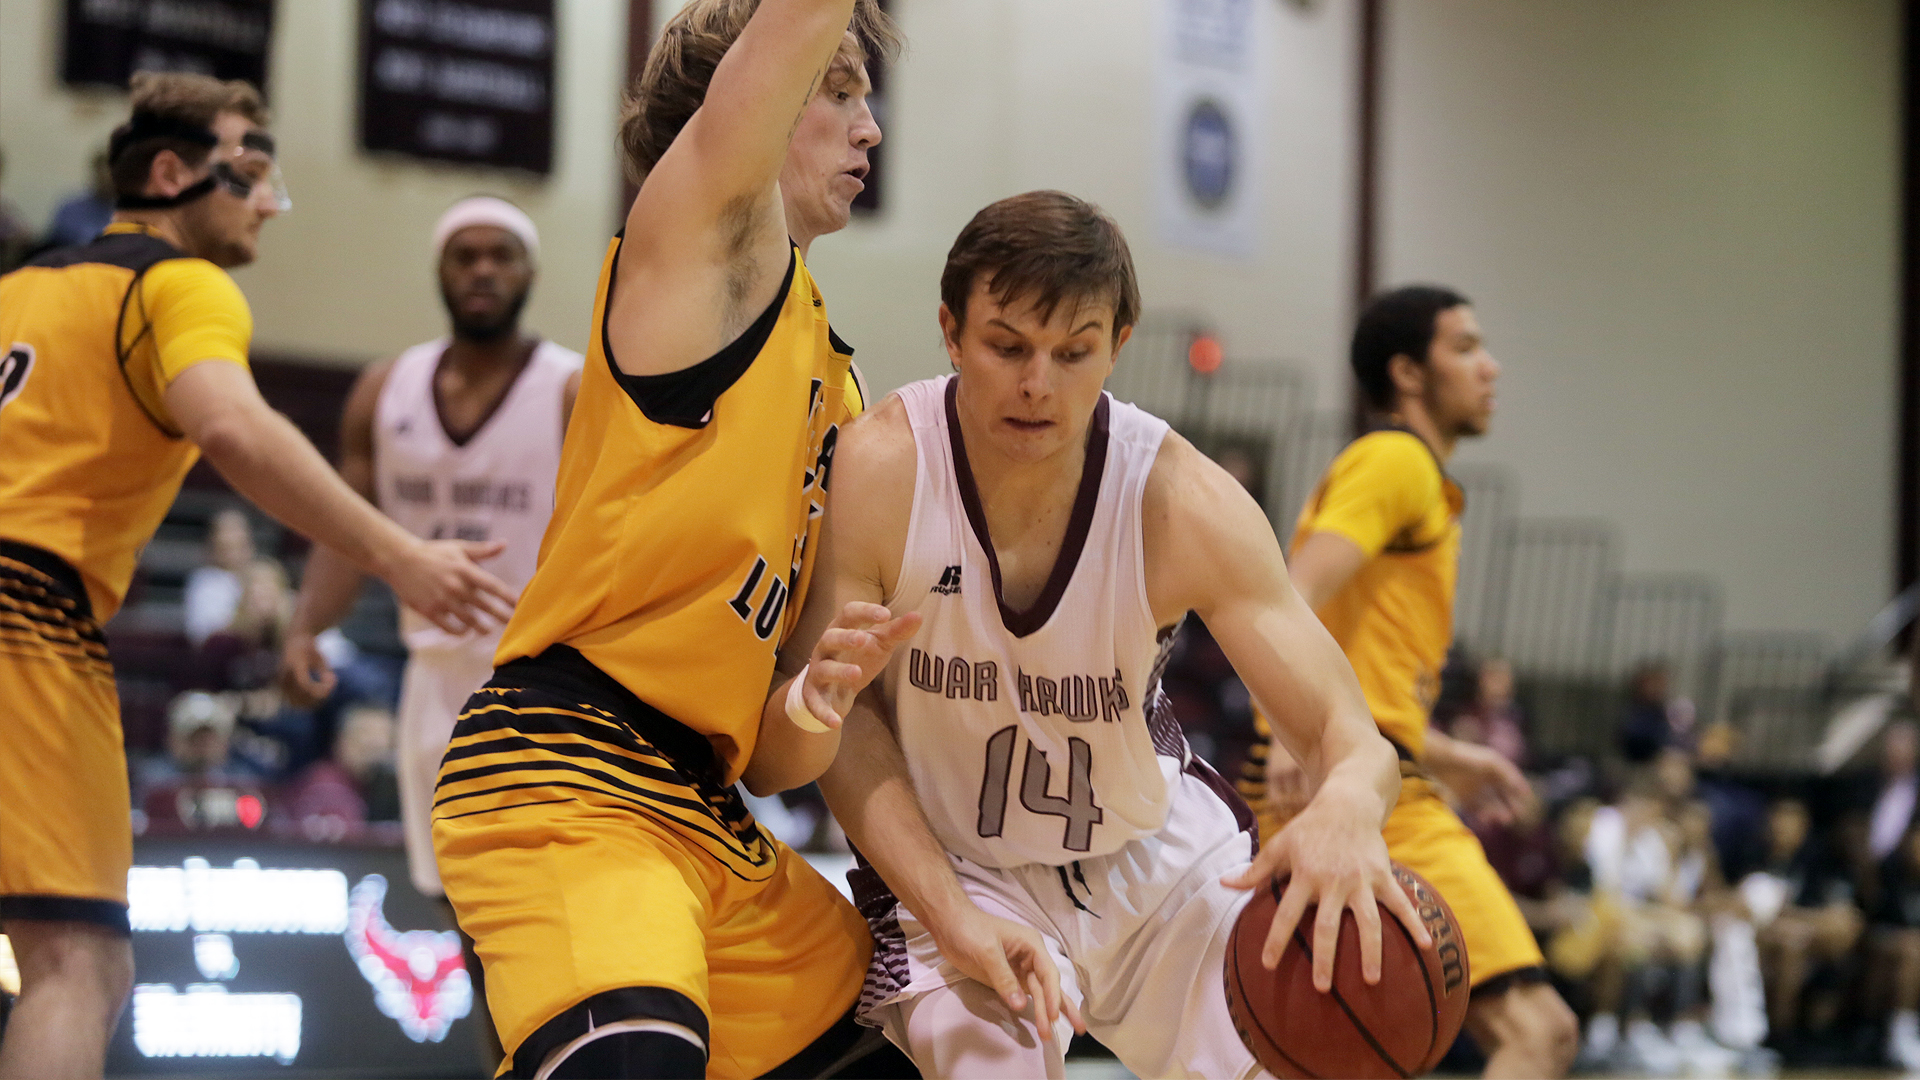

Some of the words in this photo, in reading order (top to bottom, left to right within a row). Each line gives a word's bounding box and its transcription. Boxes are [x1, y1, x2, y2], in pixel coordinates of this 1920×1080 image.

[909, 648, 998, 701] WAR
[1017, 665, 1130, 723] HAWKS
[977, 724, 1103, 852] 14
